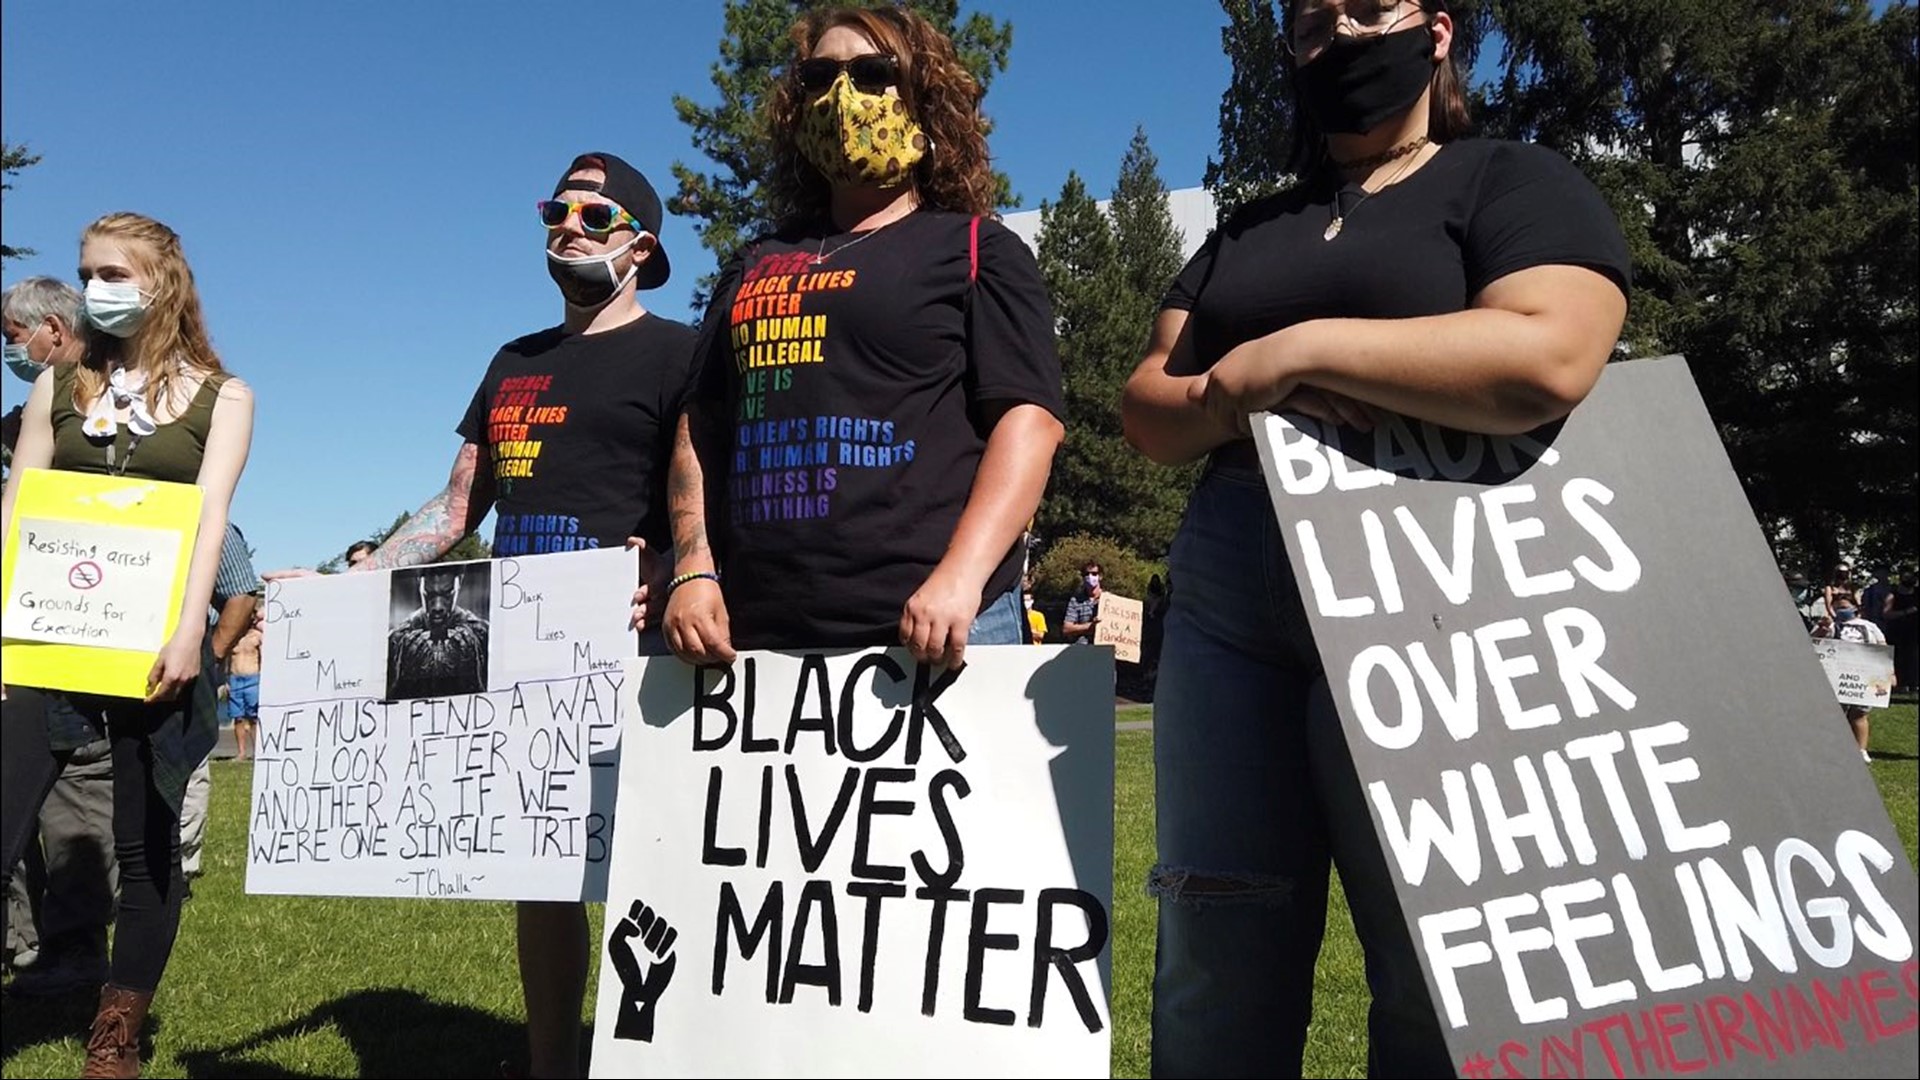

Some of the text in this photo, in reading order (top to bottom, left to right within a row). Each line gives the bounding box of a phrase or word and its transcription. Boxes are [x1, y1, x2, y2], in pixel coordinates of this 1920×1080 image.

[735, 269, 857, 301] BLACK LIVES
[731, 293, 802, 325] MATTER
[731, 315, 827, 350] NO HUMAN
[735, 340, 825, 375] IS ILLEGAL
[774, 367, 793, 391] IS
[525, 404, 568, 424] LIVES
[739, 397, 766, 421] OVE
[738, 415, 895, 447] OMEN'S RIGHTS
[760, 442, 829, 469] HUMAN
[839, 440, 916, 468] RIGHTS
[1264, 413, 1560, 495] BLACK
[816, 467, 838, 492] IS
[520, 514, 580, 534] RIGHTS
[28, 532, 151, 567] Resisting arrest
[496, 534, 600, 556] MAN RIGHTS
[1295, 477, 1642, 617] LIVES
[500, 558, 544, 609] Black
[19, 591, 126, 621] Grounds for
[536, 602, 566, 641] Lives
[31, 616, 109, 638] Execution
[573, 640, 621, 673] Matter
[316, 658, 363, 691] Matter
[1348, 606, 1637, 750] OVER
[1838, 673, 1860, 682] AND
[1838, 682, 1869, 691] MANY
[692, 653, 967, 765] BLACK
[1837, 689, 1865, 699] MORE
[256, 670, 624, 753] WE MUST FIND A WAY
[256, 722, 615, 790] TO LOOK AFTER ONE
[254, 770, 576, 831] ANOTHER AS IF WE
[1368, 720, 1731, 887] WHITE
[251, 813, 615, 864] WERE ONE SINGLE TRIB
[701, 763, 971, 888] LIVES
[1418, 829, 1914, 1029] FEELINGS
[711, 880, 1109, 1034] MATTER
